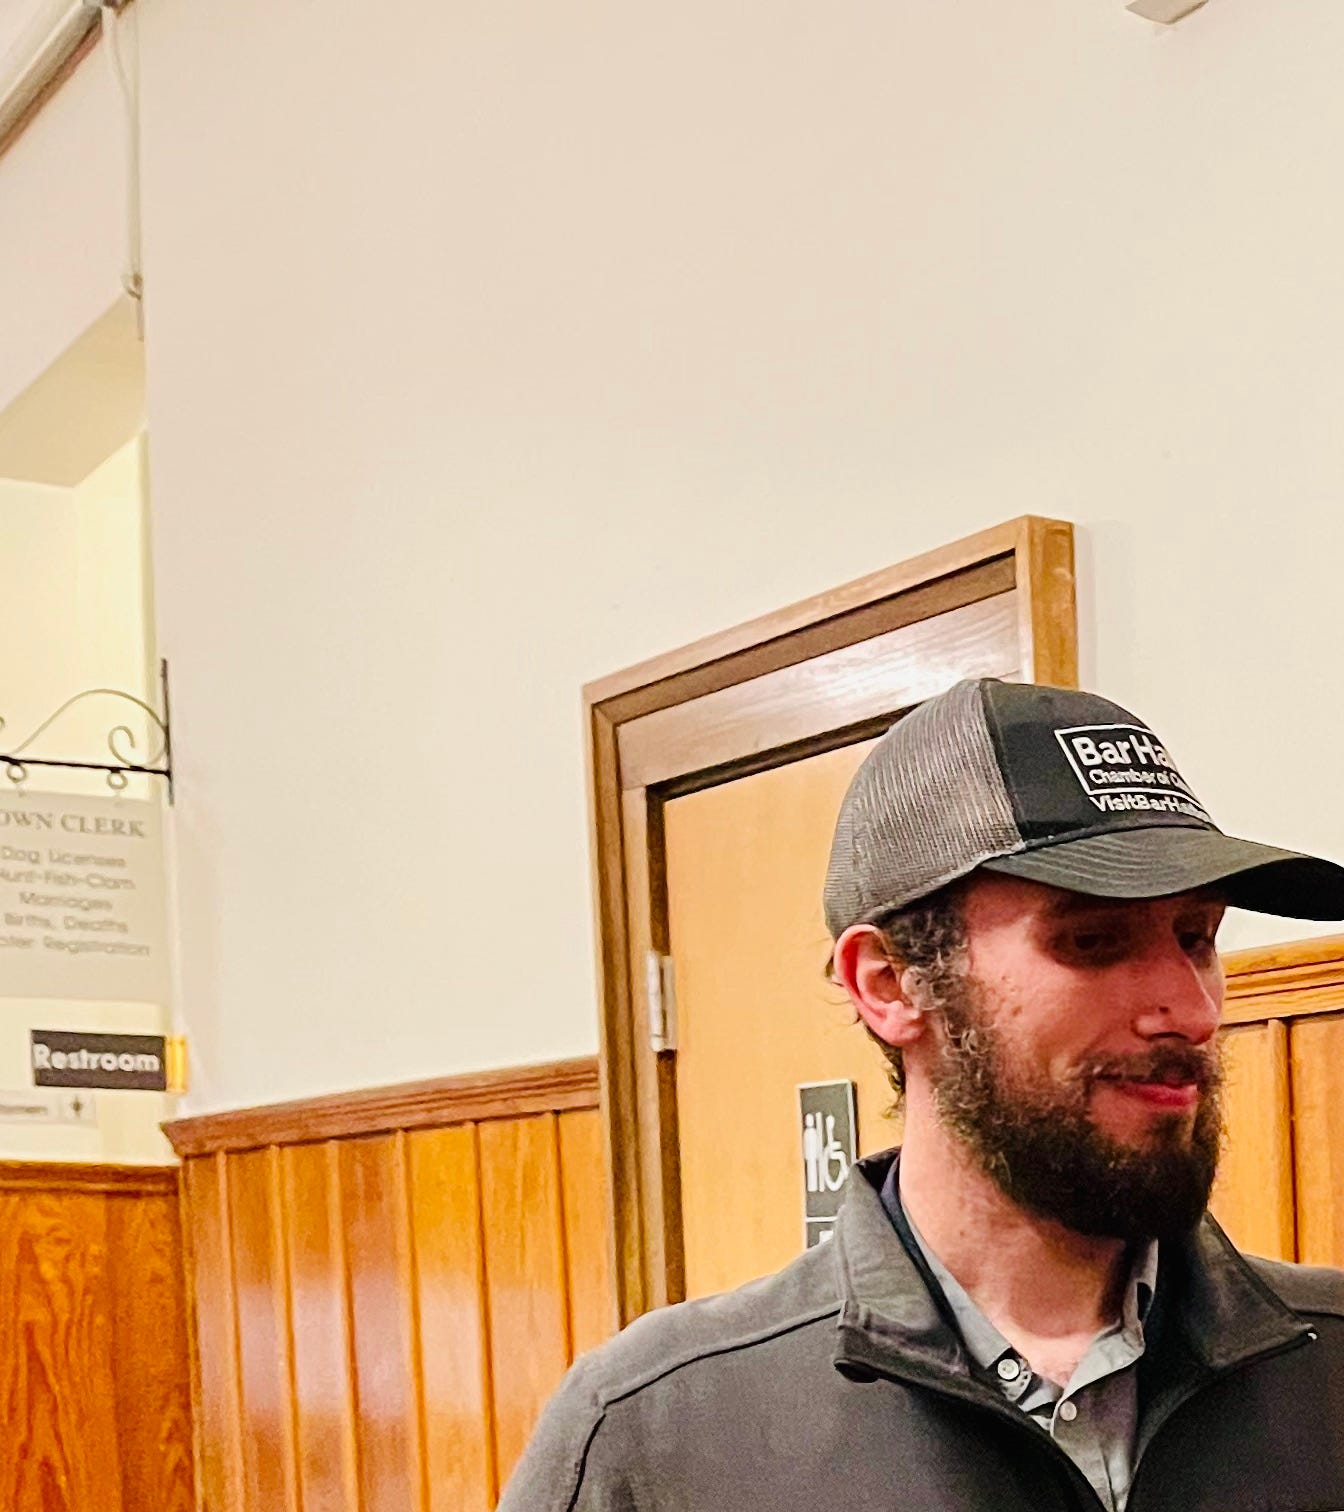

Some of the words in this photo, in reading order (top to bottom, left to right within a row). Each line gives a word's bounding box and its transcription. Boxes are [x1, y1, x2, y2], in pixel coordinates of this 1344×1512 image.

[1089, 768, 1156, 785] Chamber
[60, 813, 147, 839] CLERK
[32, 1043, 160, 1072] Restroom
